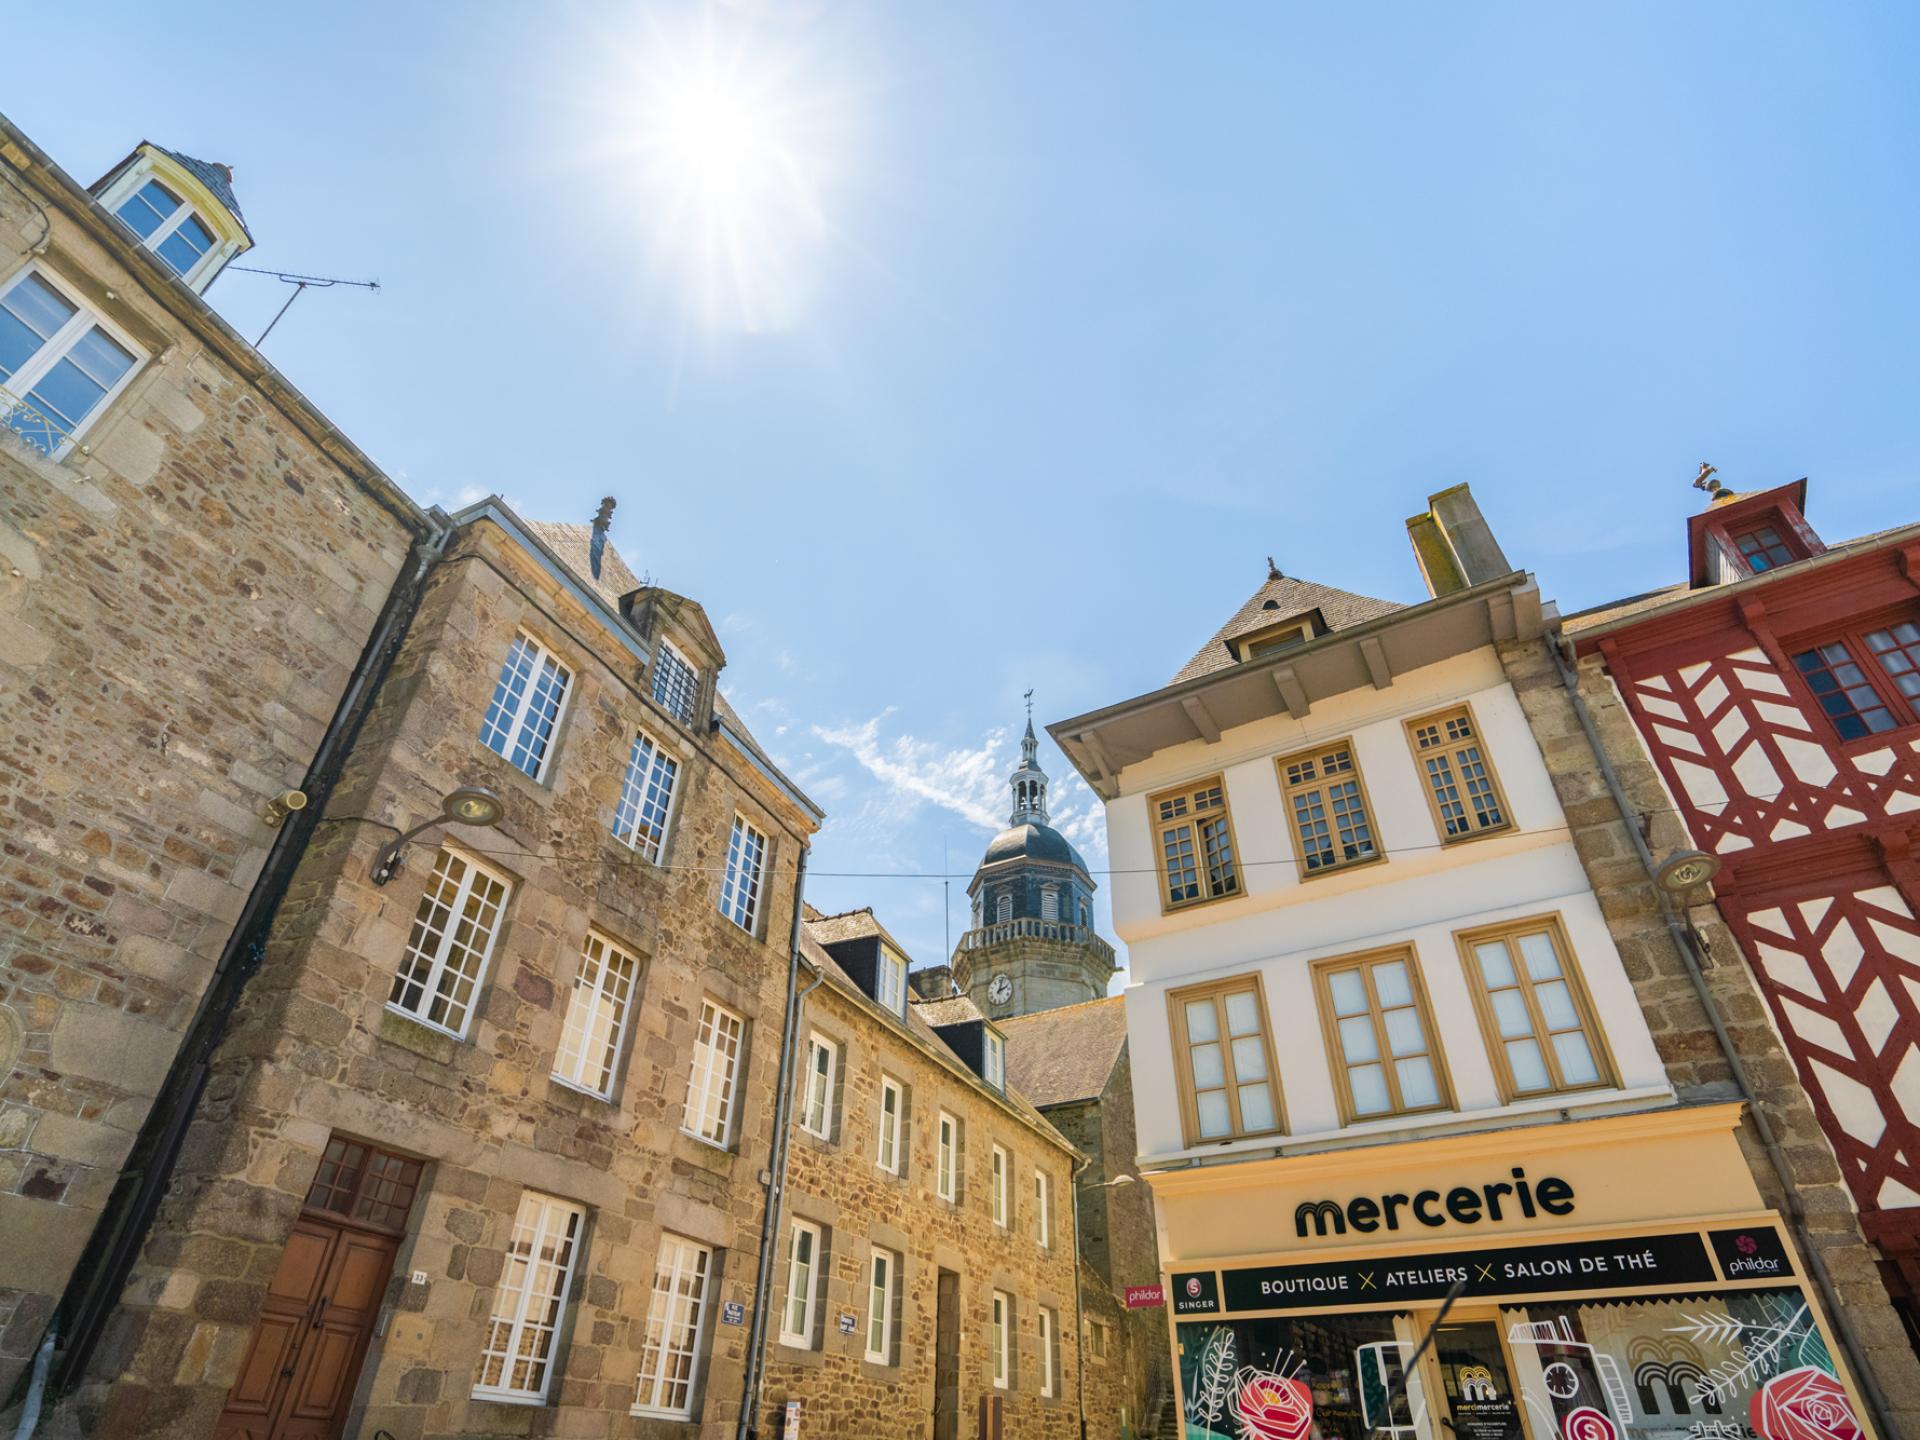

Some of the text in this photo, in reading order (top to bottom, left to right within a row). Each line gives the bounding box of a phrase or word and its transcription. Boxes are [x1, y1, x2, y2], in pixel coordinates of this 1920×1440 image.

[1295, 1167, 1575, 1237] mercerie
[1261, 1276, 1349, 1294] BOUTIQUE
[1386, 1267, 1468, 1287] ATELIERS
[1504, 1259, 1573, 1278] SALON
[1579, 1256, 1608, 1273] DE
[1613, 1249, 1657, 1270] THÉ
[1729, 1257, 1778, 1275] phildar
[1129, 1289, 1161, 1304] phildar
[1178, 1300, 1214, 1310] SINGER
